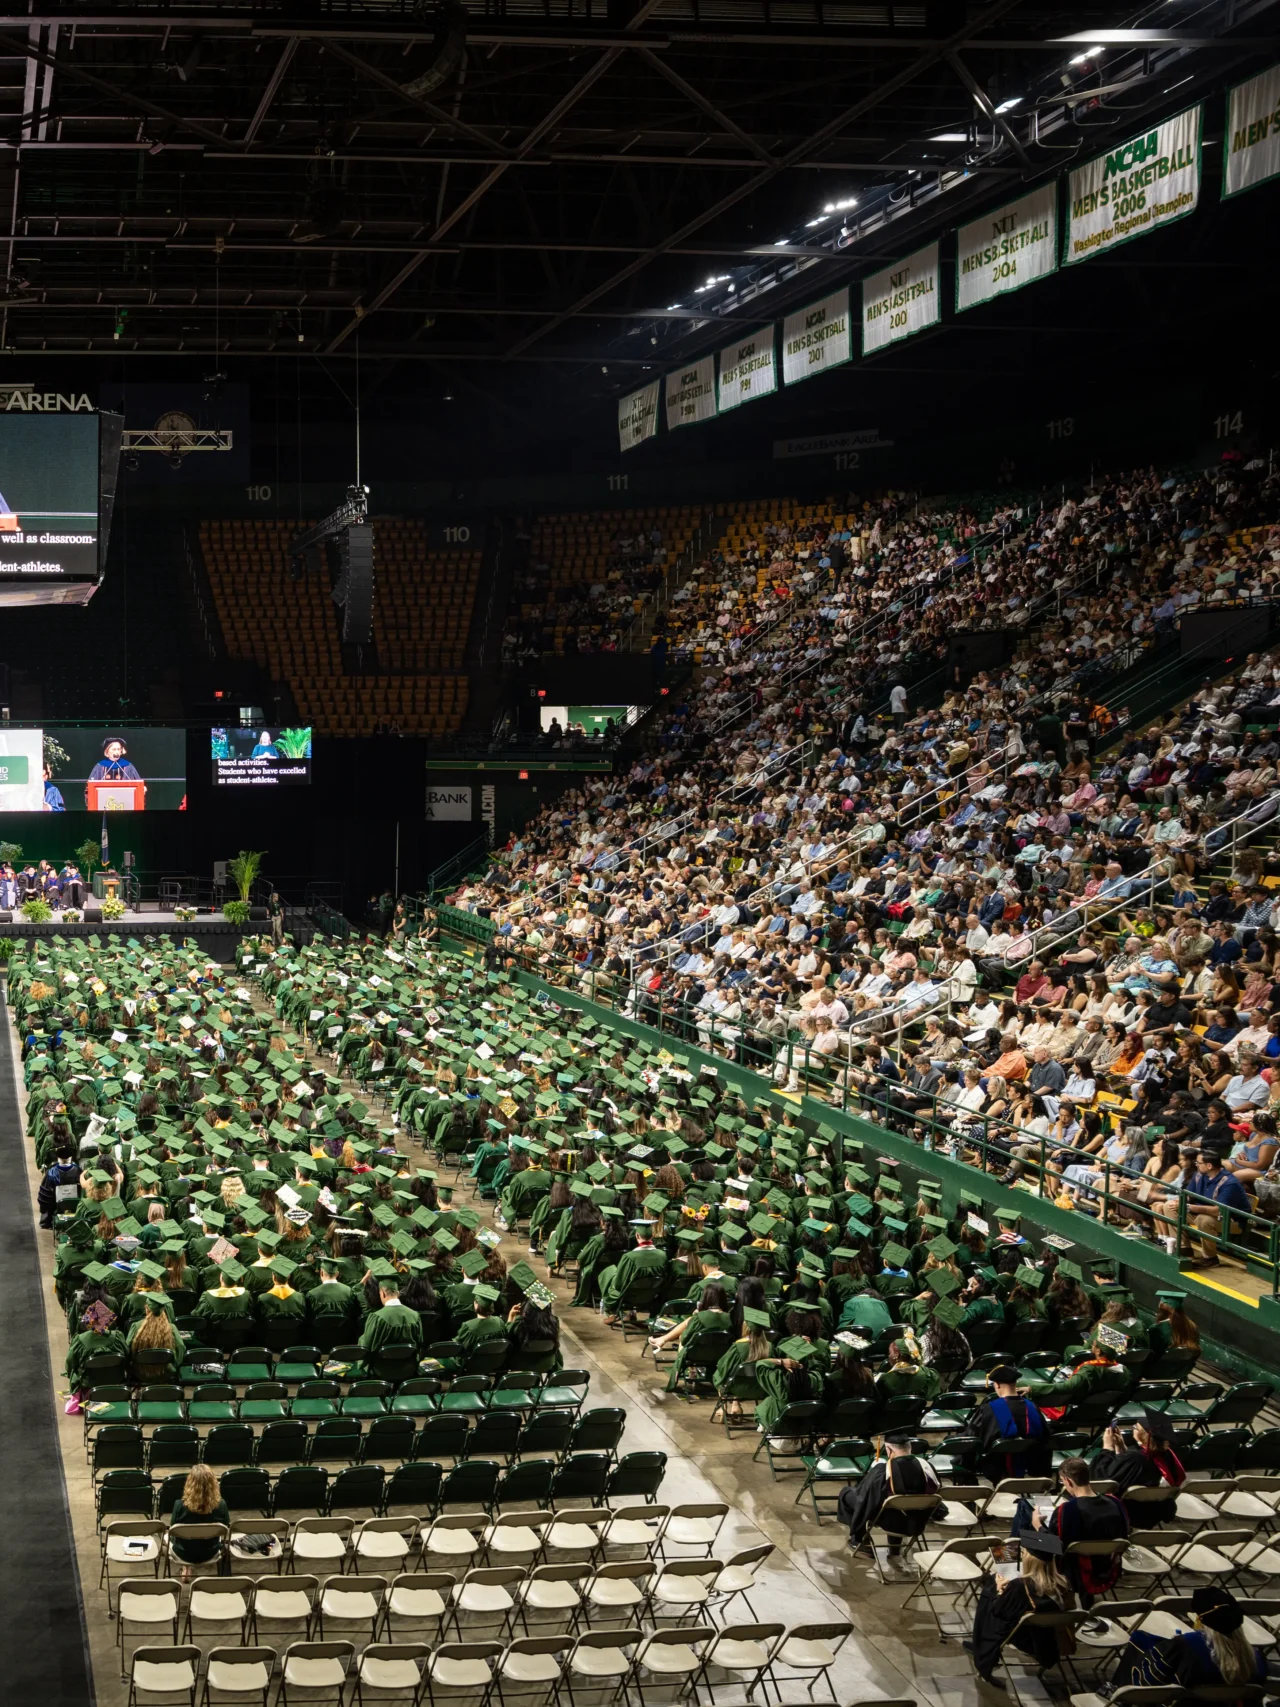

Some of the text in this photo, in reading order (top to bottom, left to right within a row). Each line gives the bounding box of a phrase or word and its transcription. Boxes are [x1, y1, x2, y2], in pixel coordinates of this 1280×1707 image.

[1103, 130, 1158, 182] NCAA
[1072, 144, 1194, 220] MEN'S BASKETBALL
[1112, 190, 1146, 221] 2006
[1114, 207, 1151, 235] Regional
[1046, 416, 1075, 441] 113
[1213, 409, 1245, 440] 114
[833, 451, 860, 471] 112
[606, 474, 629, 491] 111
[245, 485, 272, 501] 110
[1, 532, 24, 544] well
[26, 534, 38, 544] as
[39, 532, 98, 544] classroom-
[442, 526, 471, 543] 110
[218, 767, 246, 775] Students
[247, 767, 261, 775] who
[424, 791, 469, 804] BANK
